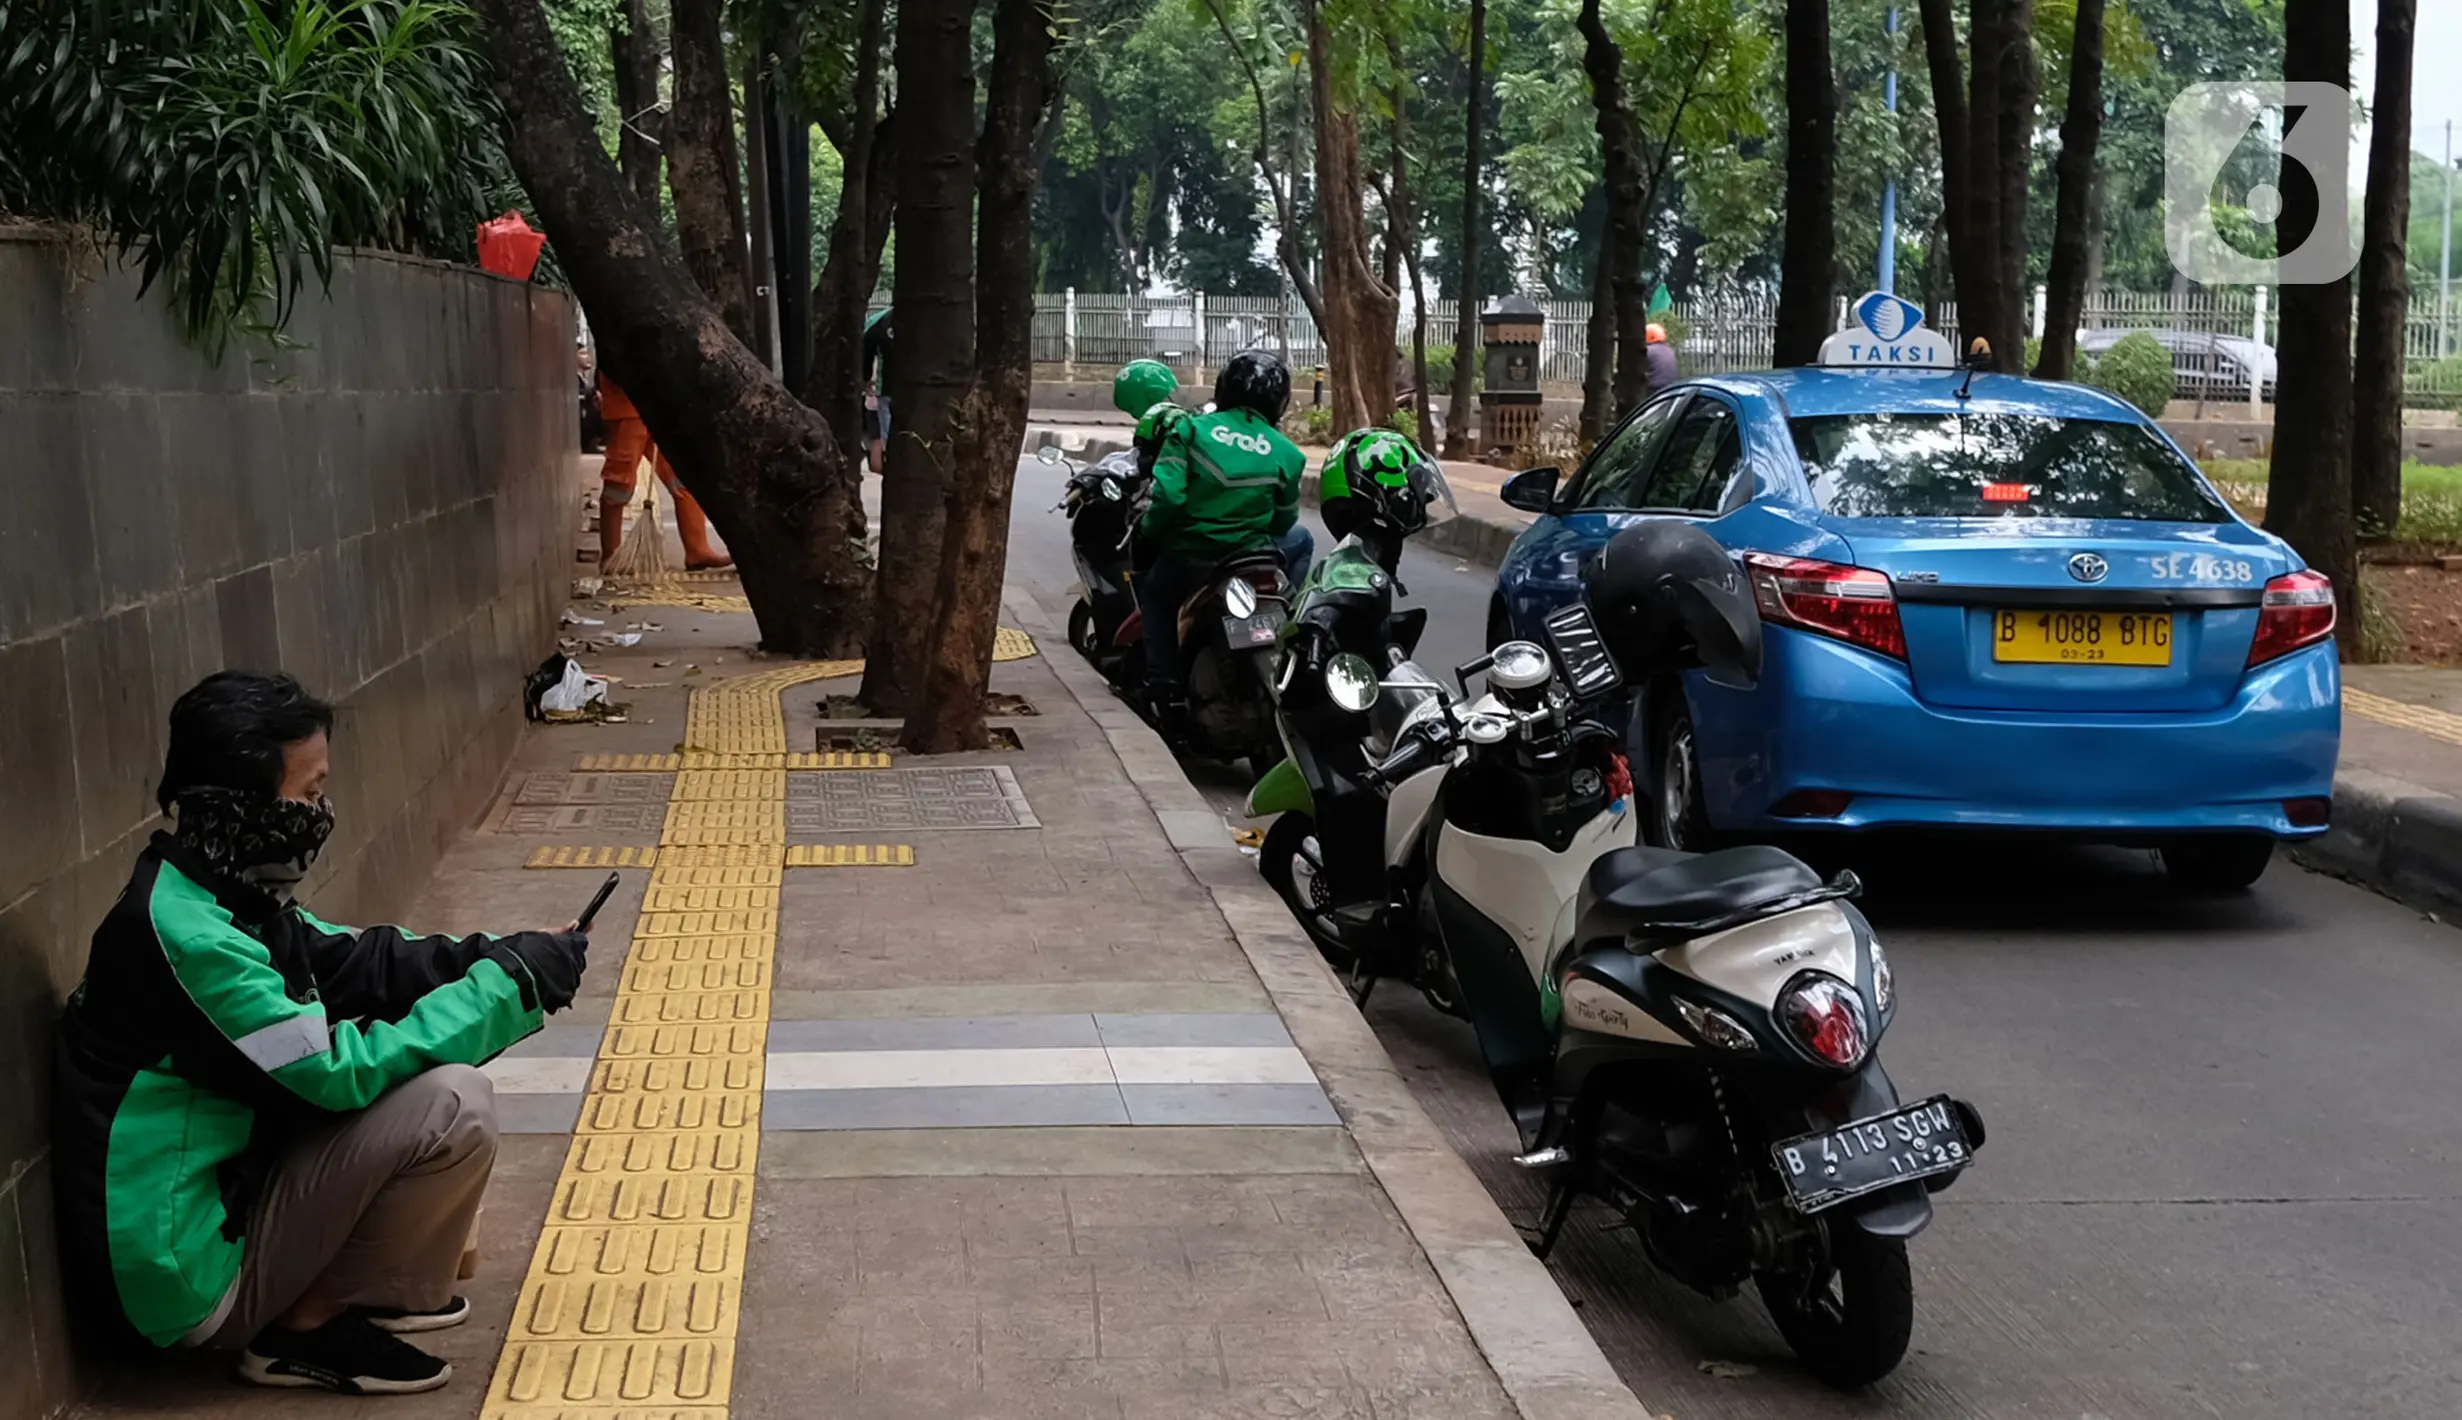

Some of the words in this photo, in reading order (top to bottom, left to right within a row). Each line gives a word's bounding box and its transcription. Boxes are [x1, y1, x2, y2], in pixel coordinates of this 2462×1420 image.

[1848, 344, 1934, 363] TAKSI
[1210, 425, 1272, 456] Grab
[2151, 552, 2185, 579] SE
[2188, 555, 2253, 583] 4638
[2000, 612, 2017, 643] B
[2038, 614, 2102, 645] 1088
[2118, 615, 2169, 647] BTG
[1783, 1147, 1806, 1176] B
[1822, 1123, 1888, 1164] 4113
[1893, 1102, 1951, 1142] SGW
